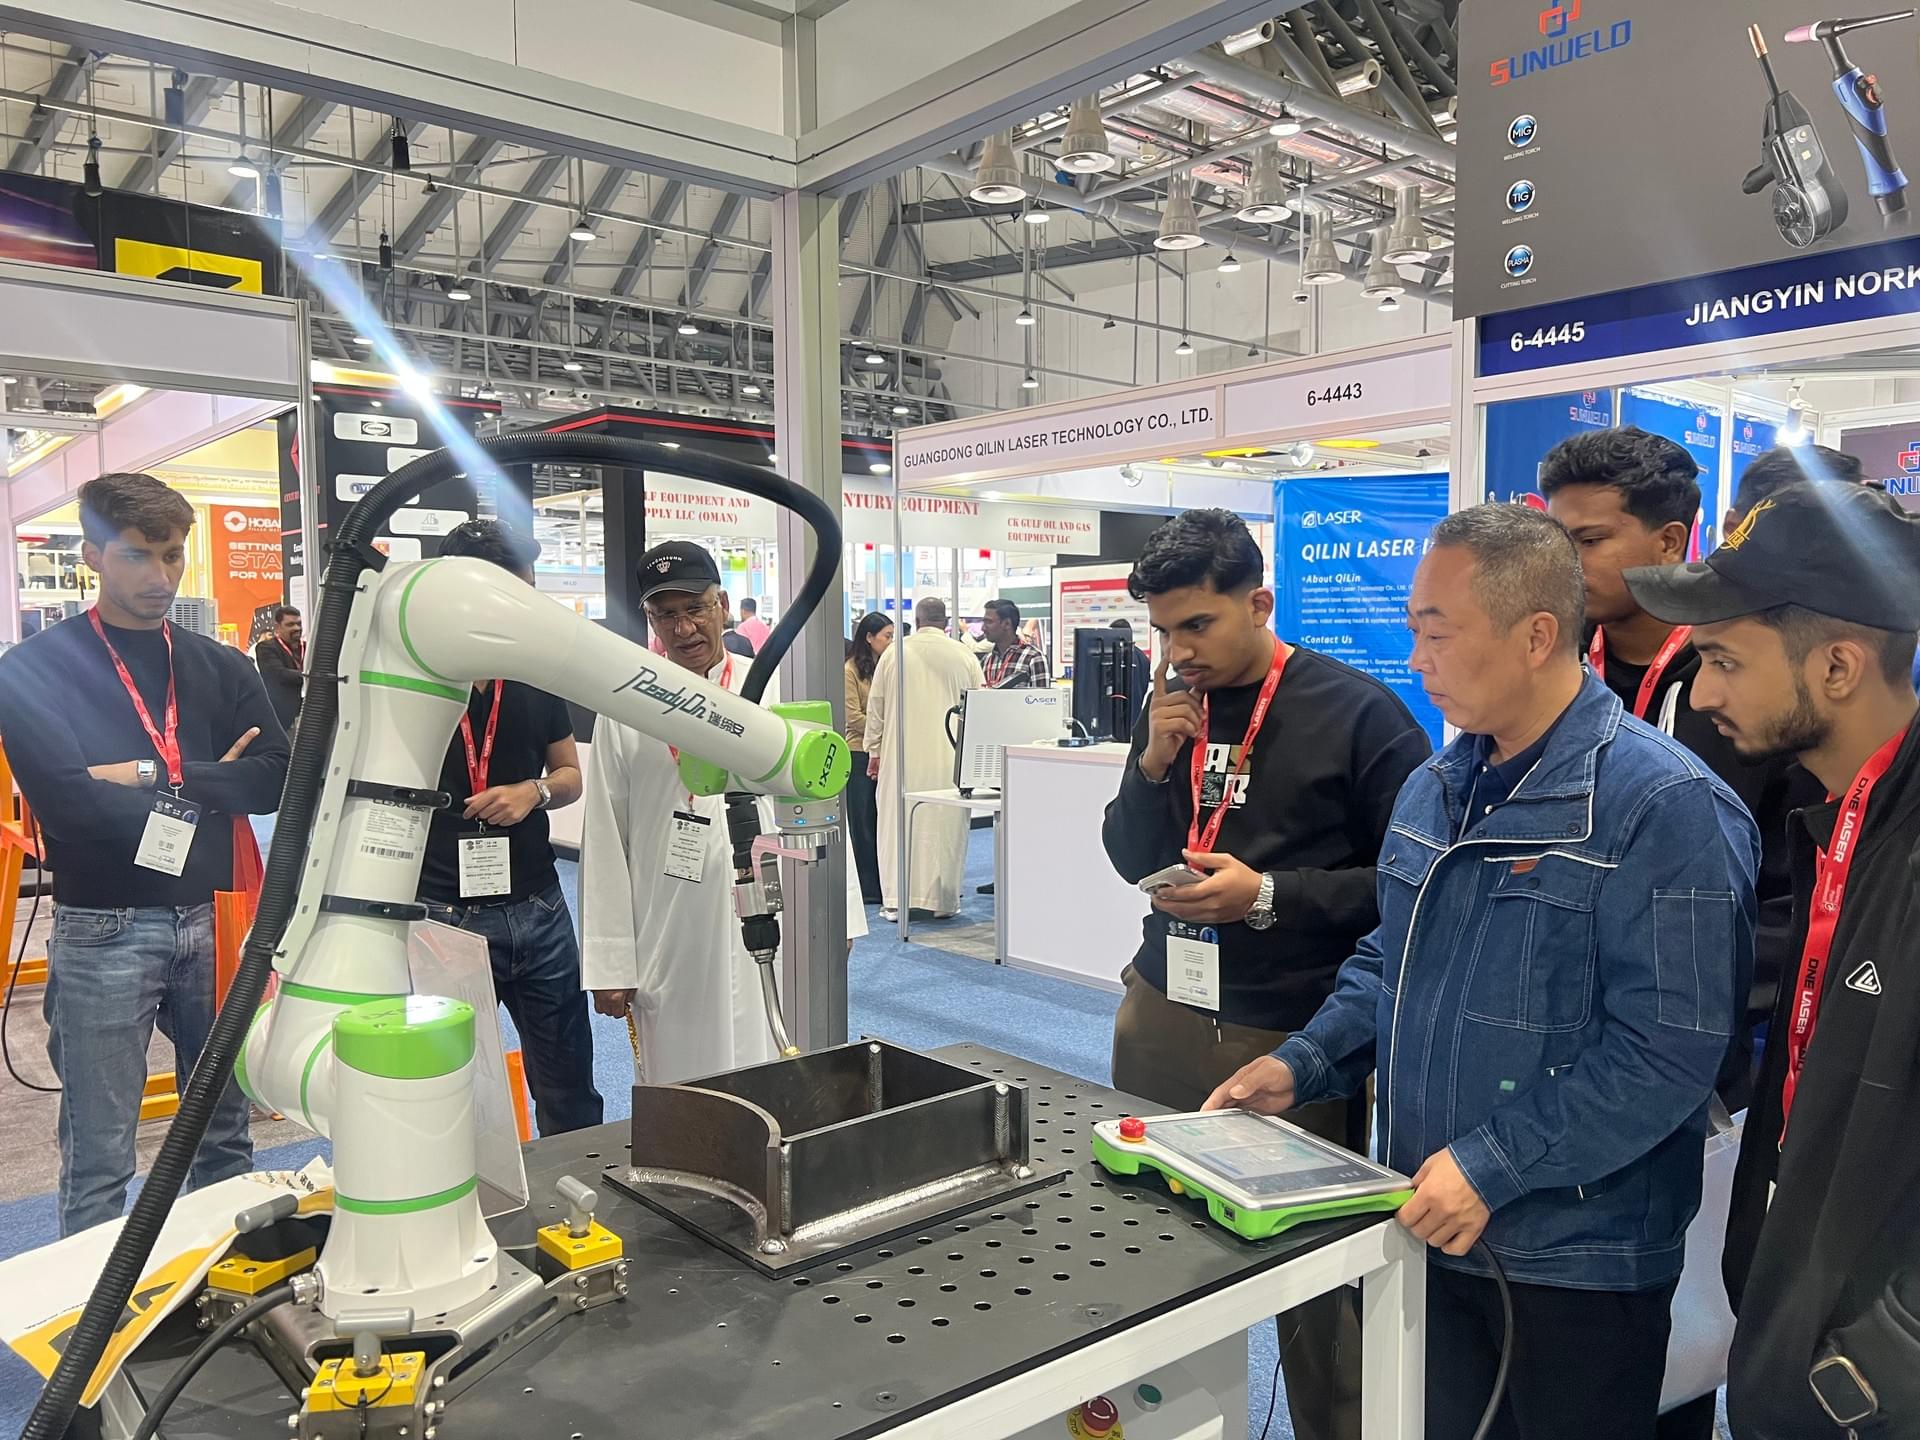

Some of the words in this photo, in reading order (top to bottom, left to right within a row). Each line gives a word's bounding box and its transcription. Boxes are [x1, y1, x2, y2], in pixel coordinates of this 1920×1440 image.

[1490, 19, 1632, 86] SUNWELD
[1512, 125, 1532, 139] MIG
[1512, 191, 1529, 203] TIG
[1508, 257, 1529, 267] PLASMA
[1685, 281, 1824, 327] JIANGYIN
[1510, 321, 1585, 353] 6-4445
[1307, 383, 1362, 406] 6-4443
[1569, 406, 1609, 427] SUNWELD
[904, 445, 972, 468] GUANGDONG
[975, 440, 1005, 457] QILIN
[1008, 434, 1049, 452] LASER
[1052, 417, 1144, 447] TECHNOLOGY
[1148, 412, 1177, 430] CO.,
[1182, 407, 1213, 425] LTD.
[660, 491, 726, 508] EQUIPMENT
[728, 498, 750, 509] AND
[676, 509, 695, 521] LLC
[699, 511, 738, 525] (OMAN)
[1008, 517, 1019, 528] CK
[1021, 518, 1042, 529] GULF
[1043, 520, 1058, 531] OIL
[1058, 521, 1074, 531] AND
[1075, 522, 1091, 532] GAS
[1317, 510, 1363, 526] LASER
[1008, 532, 1055, 544] EQUIPMENT
[1056, 534, 1071, 544] LLC
[229, 542, 282, 552] SETTING
[1301, 542, 1351, 563] QILIN
[1357, 538, 1415, 558] LASER
[229, 571, 257, 579] FOR
[1306, 574, 1333, 583] About
[1334, 573, 1361, 584] QiLin
[1305, 635, 1338, 644] Contact
[1341, 635, 1353, 644] Us
[612, 665, 707, 720] ReadyOn
[1833, 811, 1857, 863] LASER
[1794, 988, 1814, 1035] LASER
